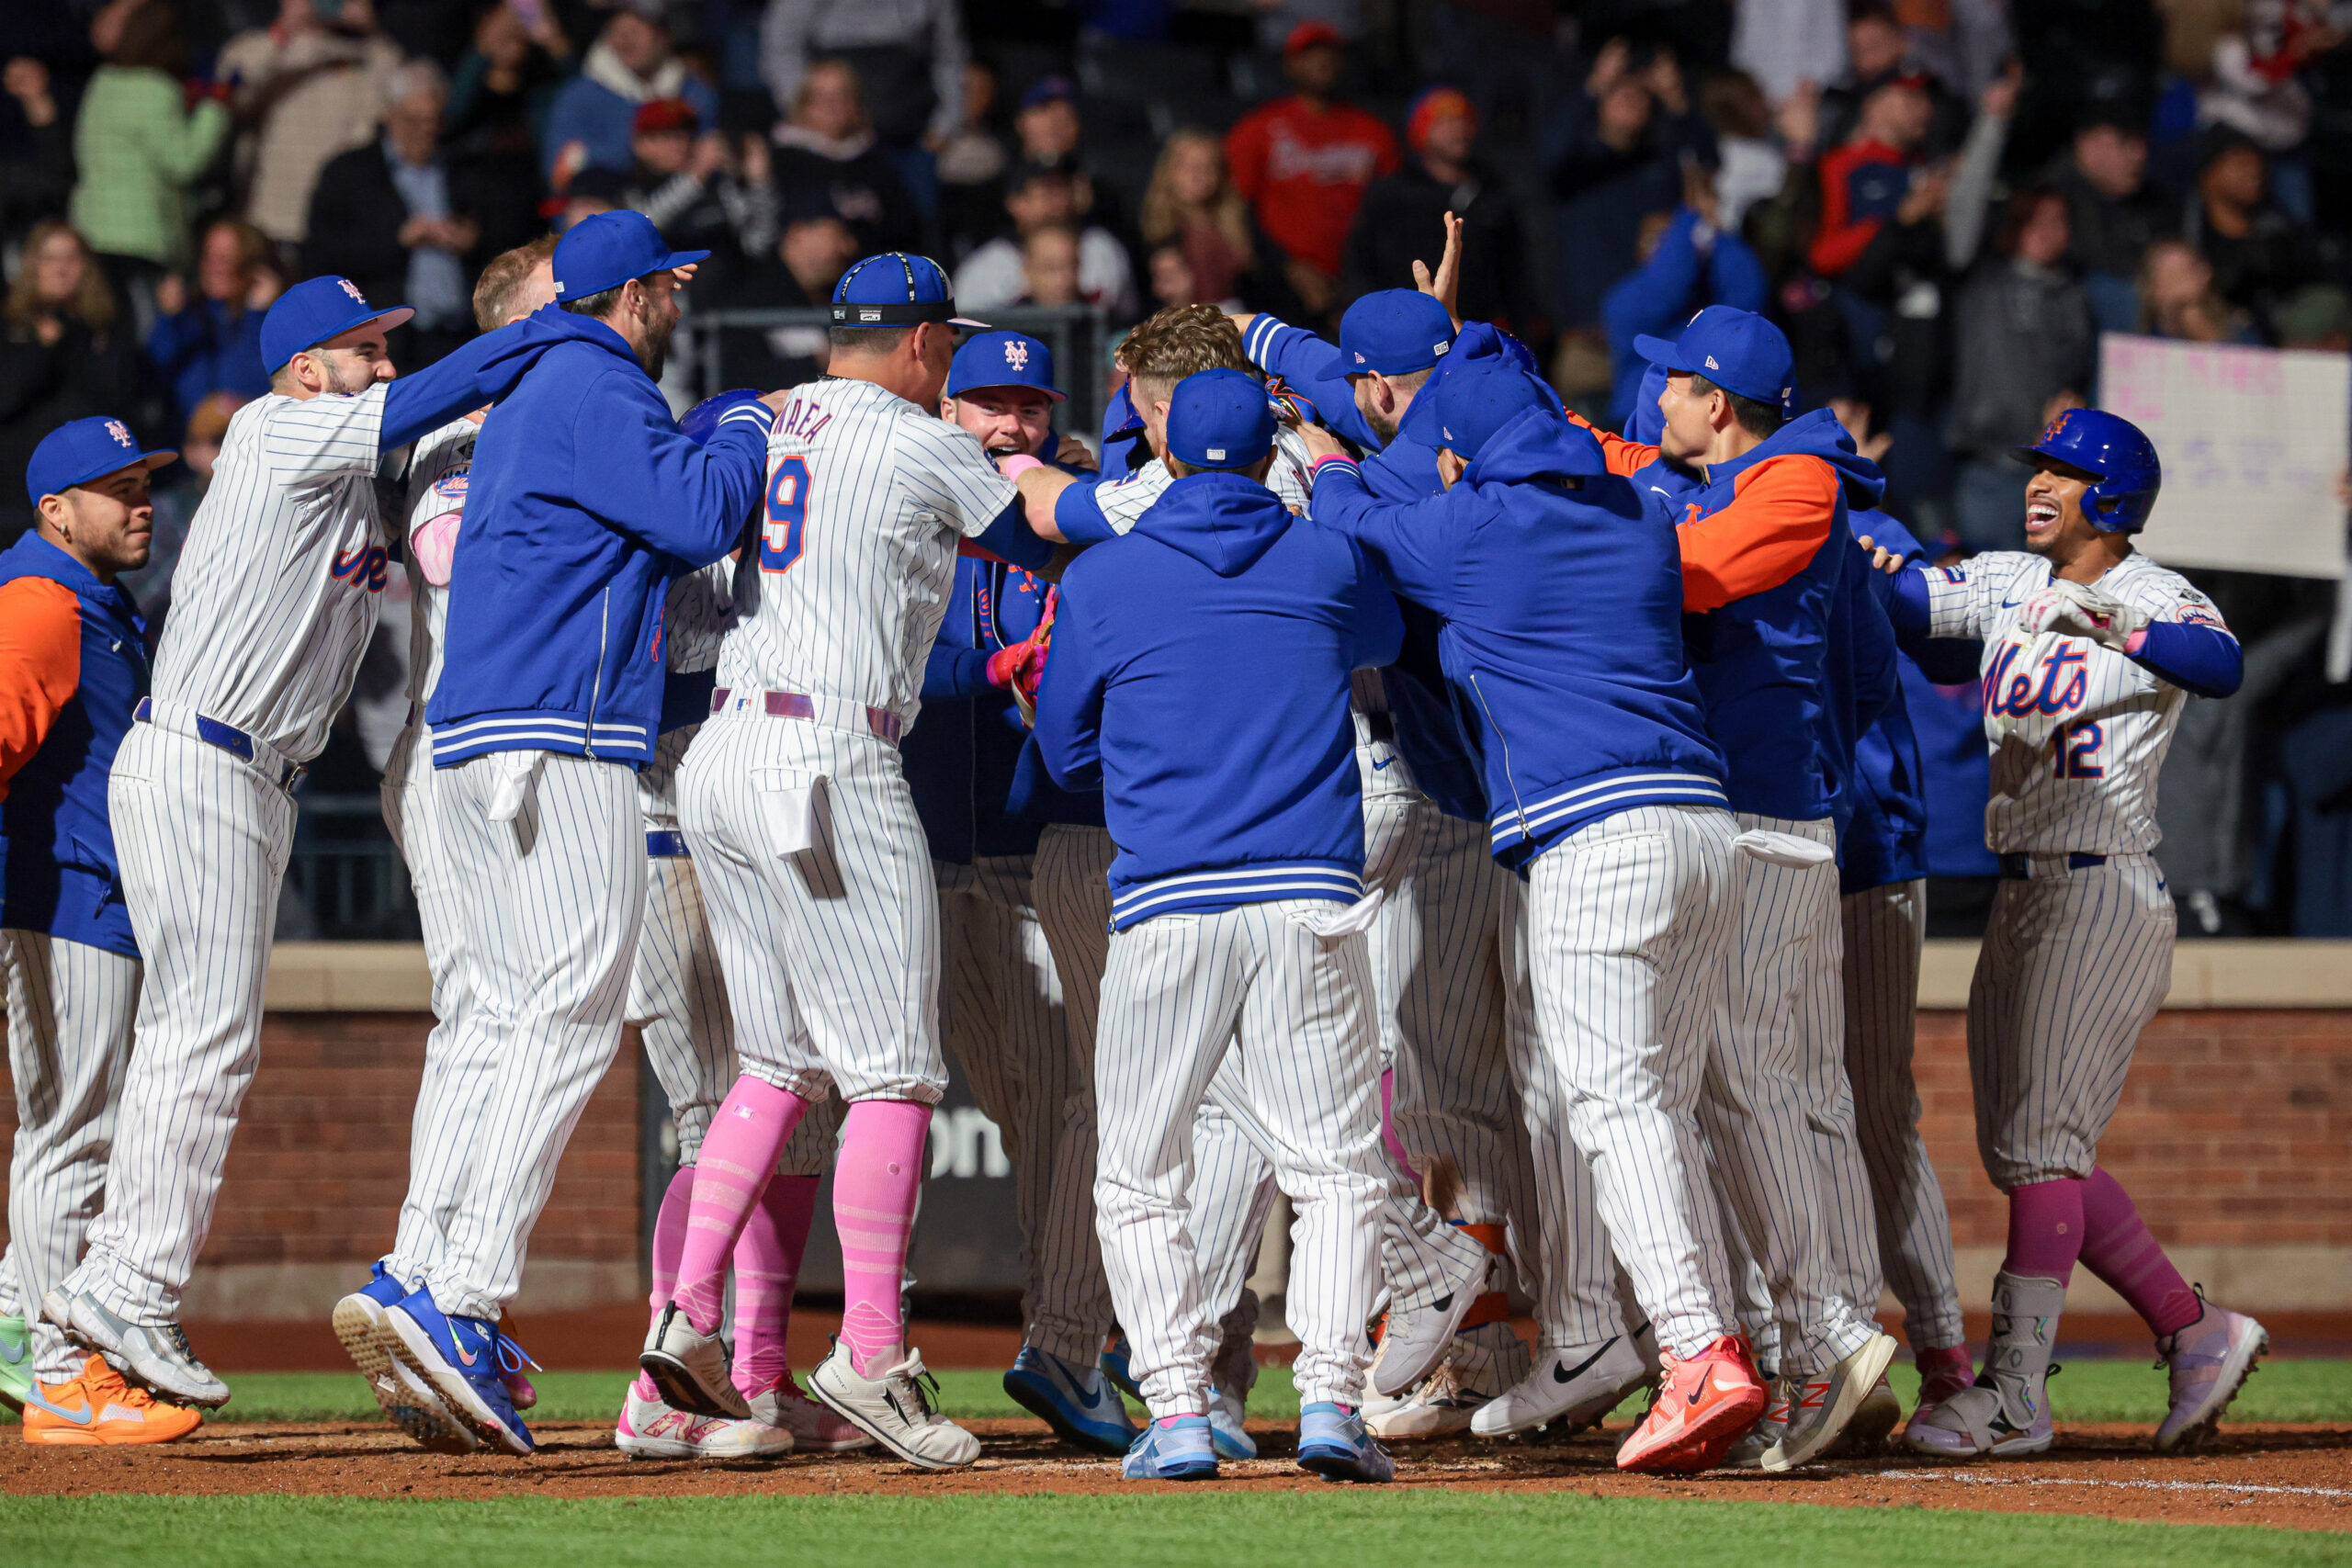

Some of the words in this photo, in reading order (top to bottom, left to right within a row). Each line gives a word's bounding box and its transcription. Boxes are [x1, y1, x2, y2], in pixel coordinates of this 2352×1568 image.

[1004, 340, 1028, 371] NY
[104, 420, 131, 448] NY
[759, 455, 812, 574] 9
[1983, 640, 2088, 718] Mets
[2052, 718, 2104, 779] 12
